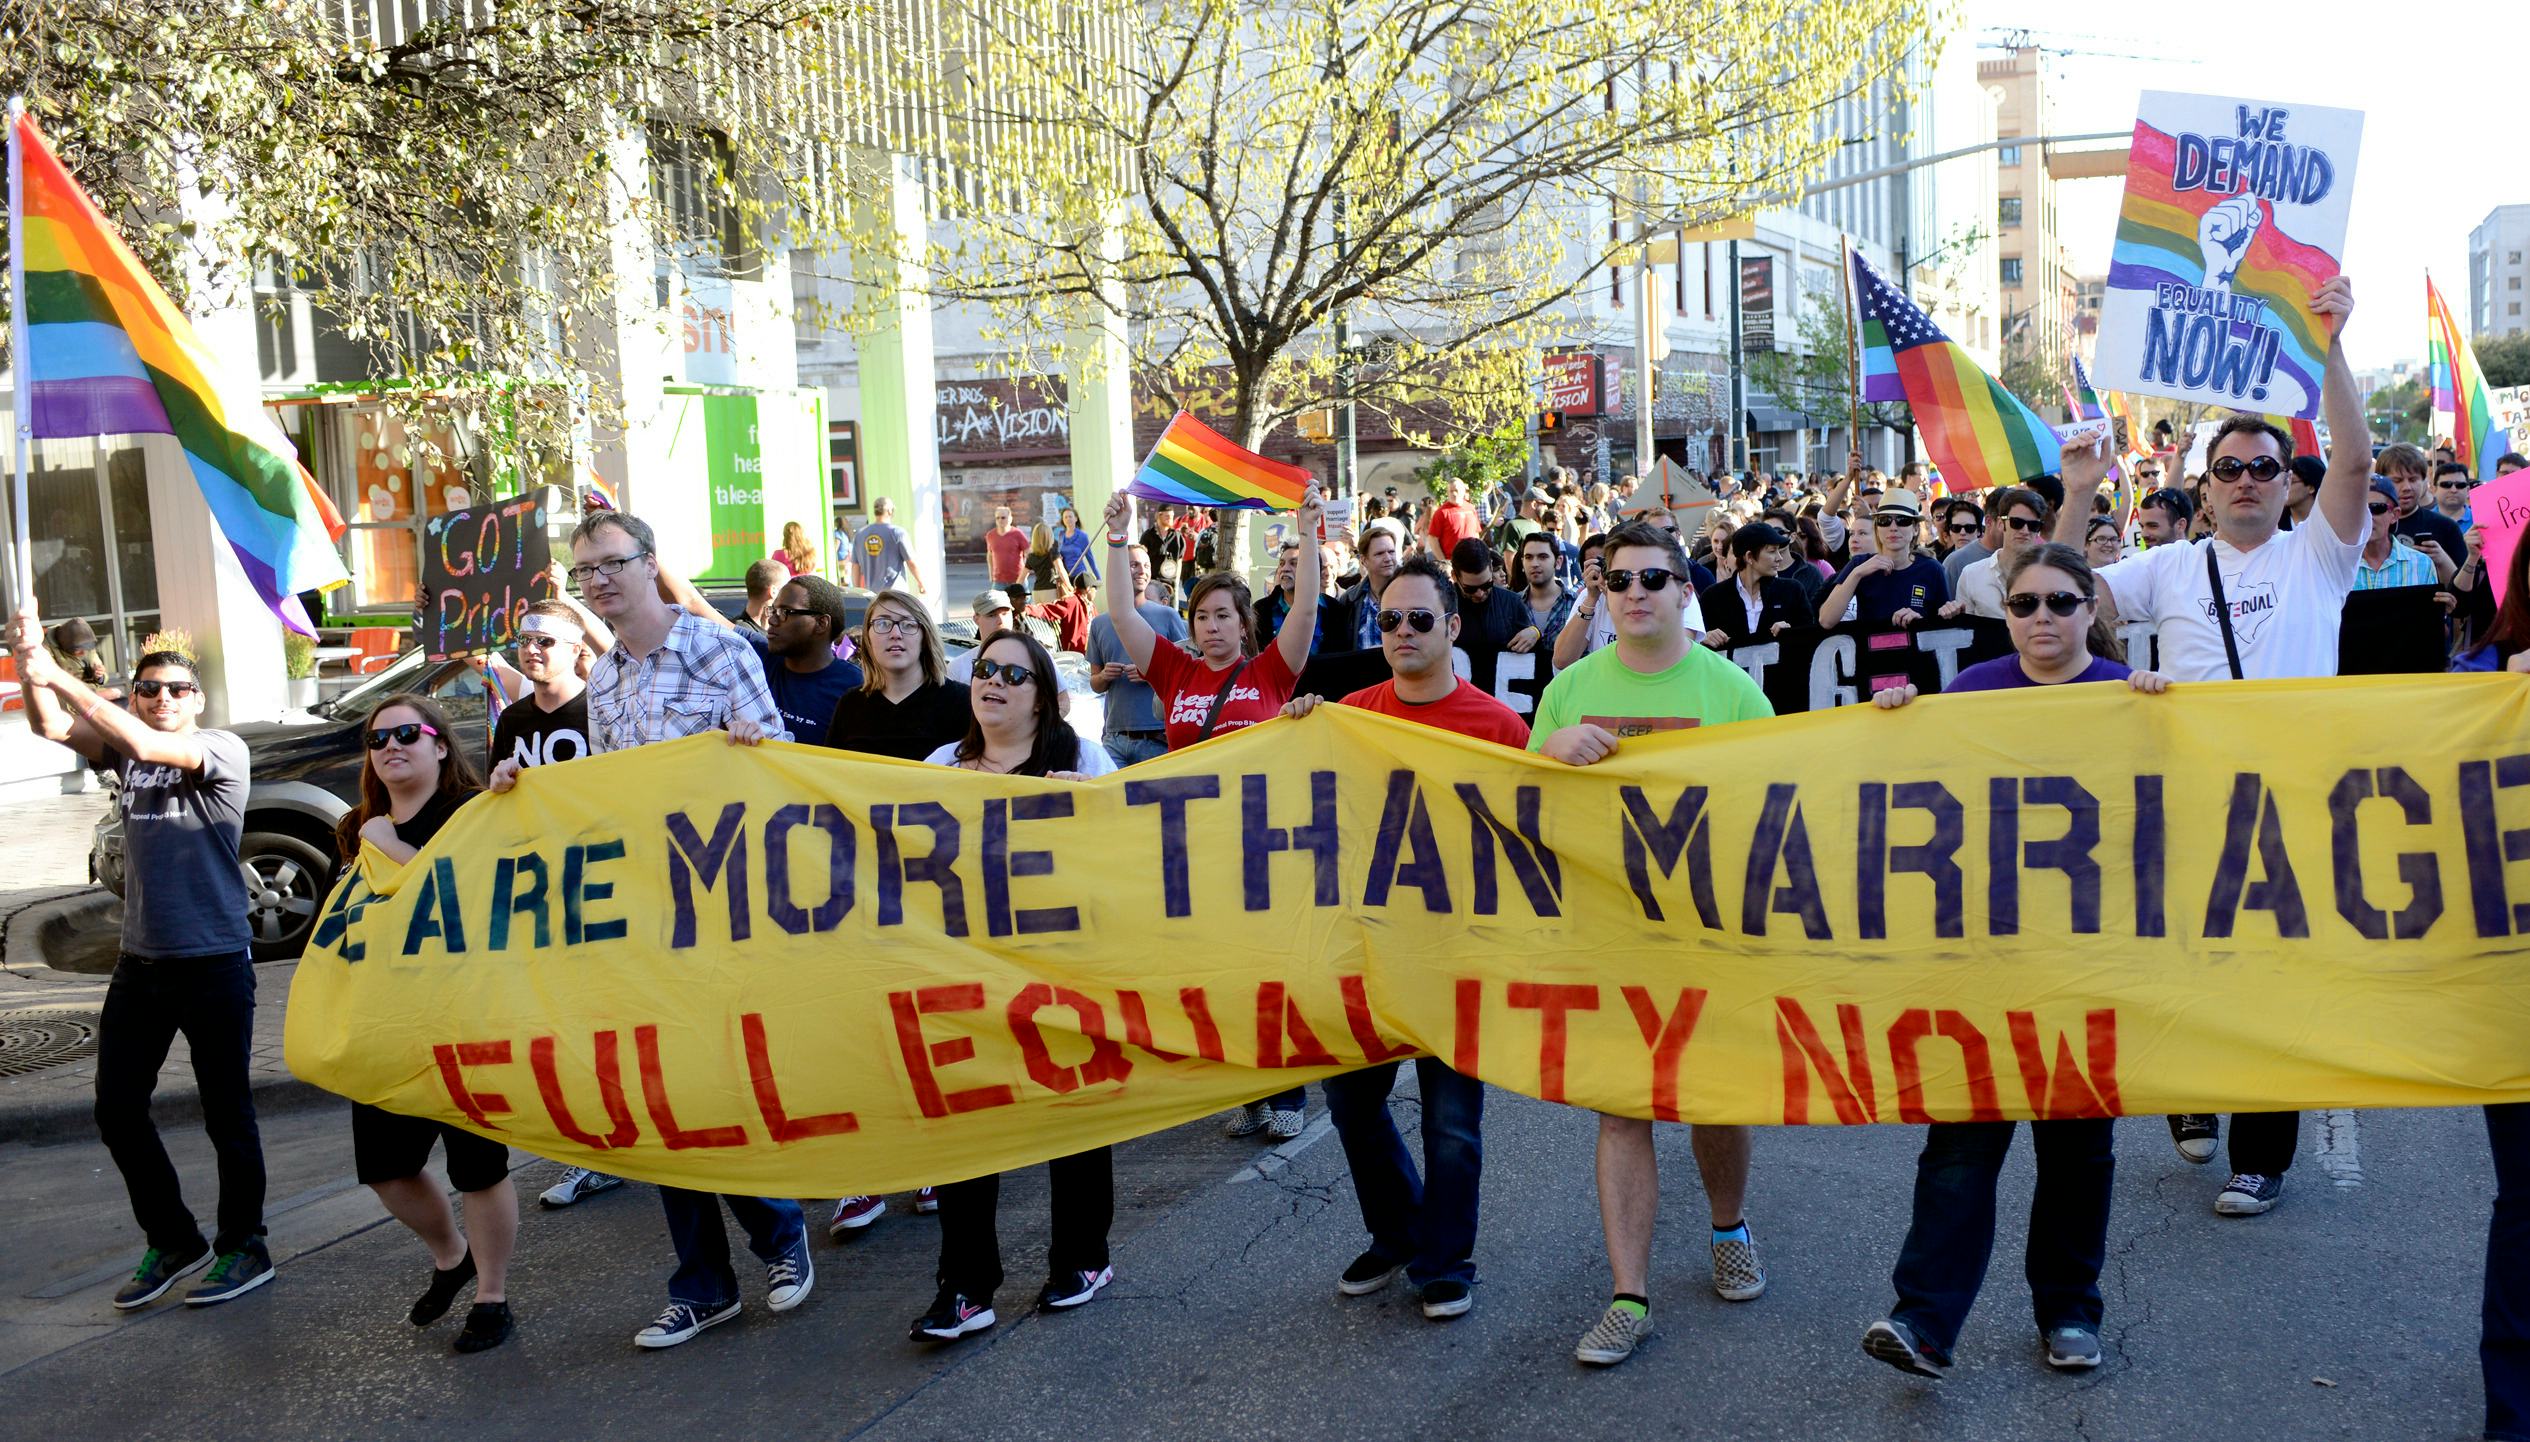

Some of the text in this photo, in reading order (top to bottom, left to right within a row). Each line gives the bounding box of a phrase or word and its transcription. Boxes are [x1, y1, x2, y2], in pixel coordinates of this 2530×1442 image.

[2236, 104, 2289, 143] WE
[2172, 132, 2335, 205] DEMAND
[2156, 282, 2271, 325] EQUALITY
[683, 305, 735, 353] sn
[2140, 307, 2283, 401] NOW!
[715, 484, 763, 505] take-a
[440, 500, 536, 577] GOT
[2207, 593, 2274, 617] GTEQUAL
[1174, 684, 1260, 709] Legize
[1617, 724, 1653, 737] KEEP
[401, 838, 627, 956] ARE
[663, 791, 1081, 949] MORE
[1125, 769, 1563, 918] THAN
[1619, 753, 2530, 940] MARRIAGE
[433, 976, 2123, 1150] FULL EQUALITY NOW
